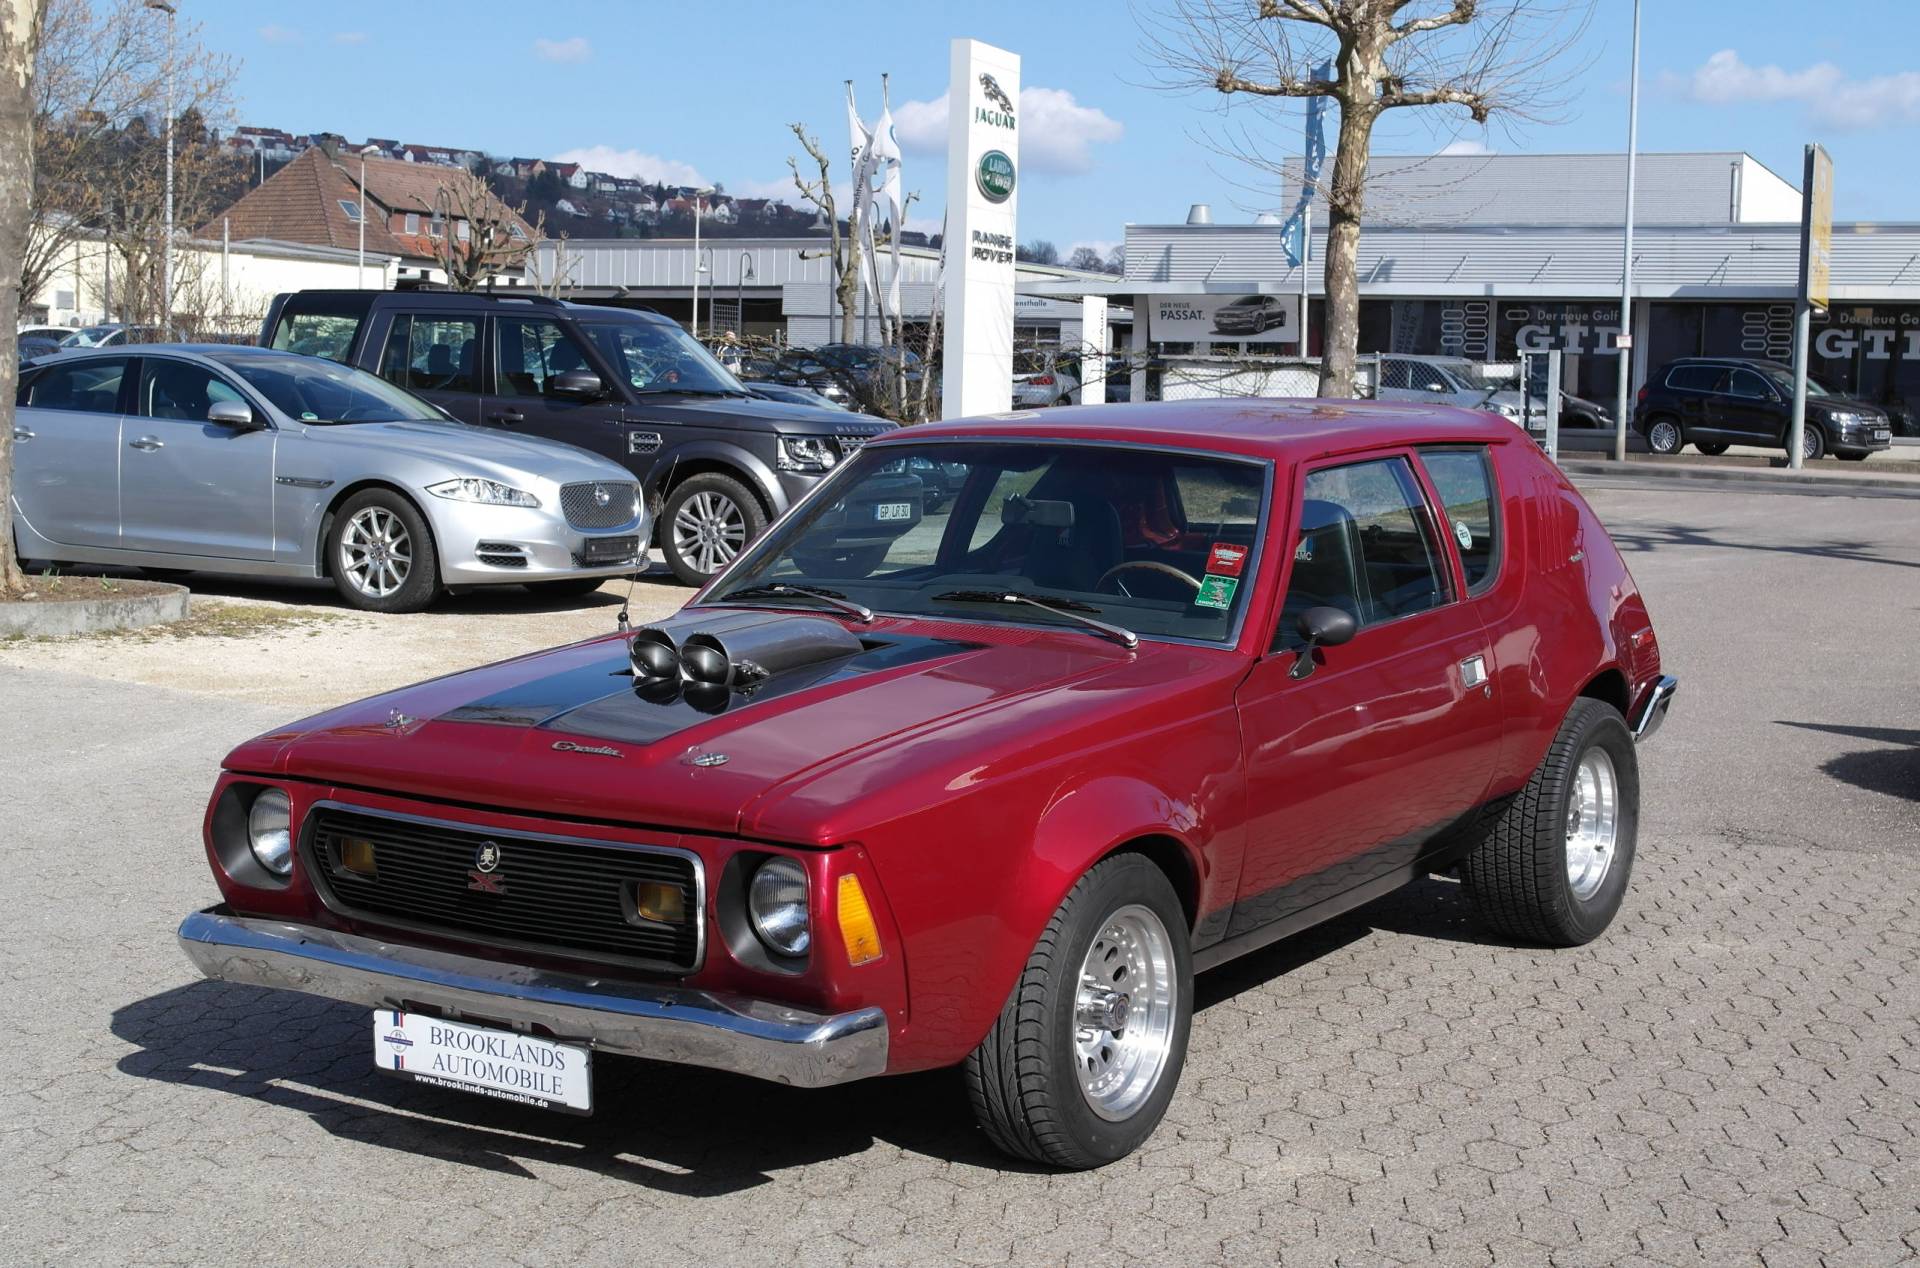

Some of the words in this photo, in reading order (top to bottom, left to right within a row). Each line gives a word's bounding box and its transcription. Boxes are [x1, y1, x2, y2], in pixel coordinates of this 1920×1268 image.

[975, 106, 1016, 130] JAGUAR
[989, 158, 1007, 173] LAND
[991, 175, 1012, 191] ROVER
[972, 230, 1012, 249] RANGE
[972, 246, 1013, 264] ROVER
[1015, 299, 1047, 307] ensthalle
[1160, 310, 1205, 321] PASSAT.
[1538, 310, 1557, 320] Der
[1592, 310, 1619, 320] Golf
[1840, 312, 1861, 324] Der
[1866, 315, 1895, 325] neue
[880, 505, 889, 518] GP
[892, 505, 900, 517] LR
[1294, 551, 1312, 561] AMC
[430, 1026, 566, 1071] BROOKLANDS
[432, 1052, 564, 1096] AUTOMOBILE
[414, 1073, 549, 1108] www.brooklands-automobile.de
